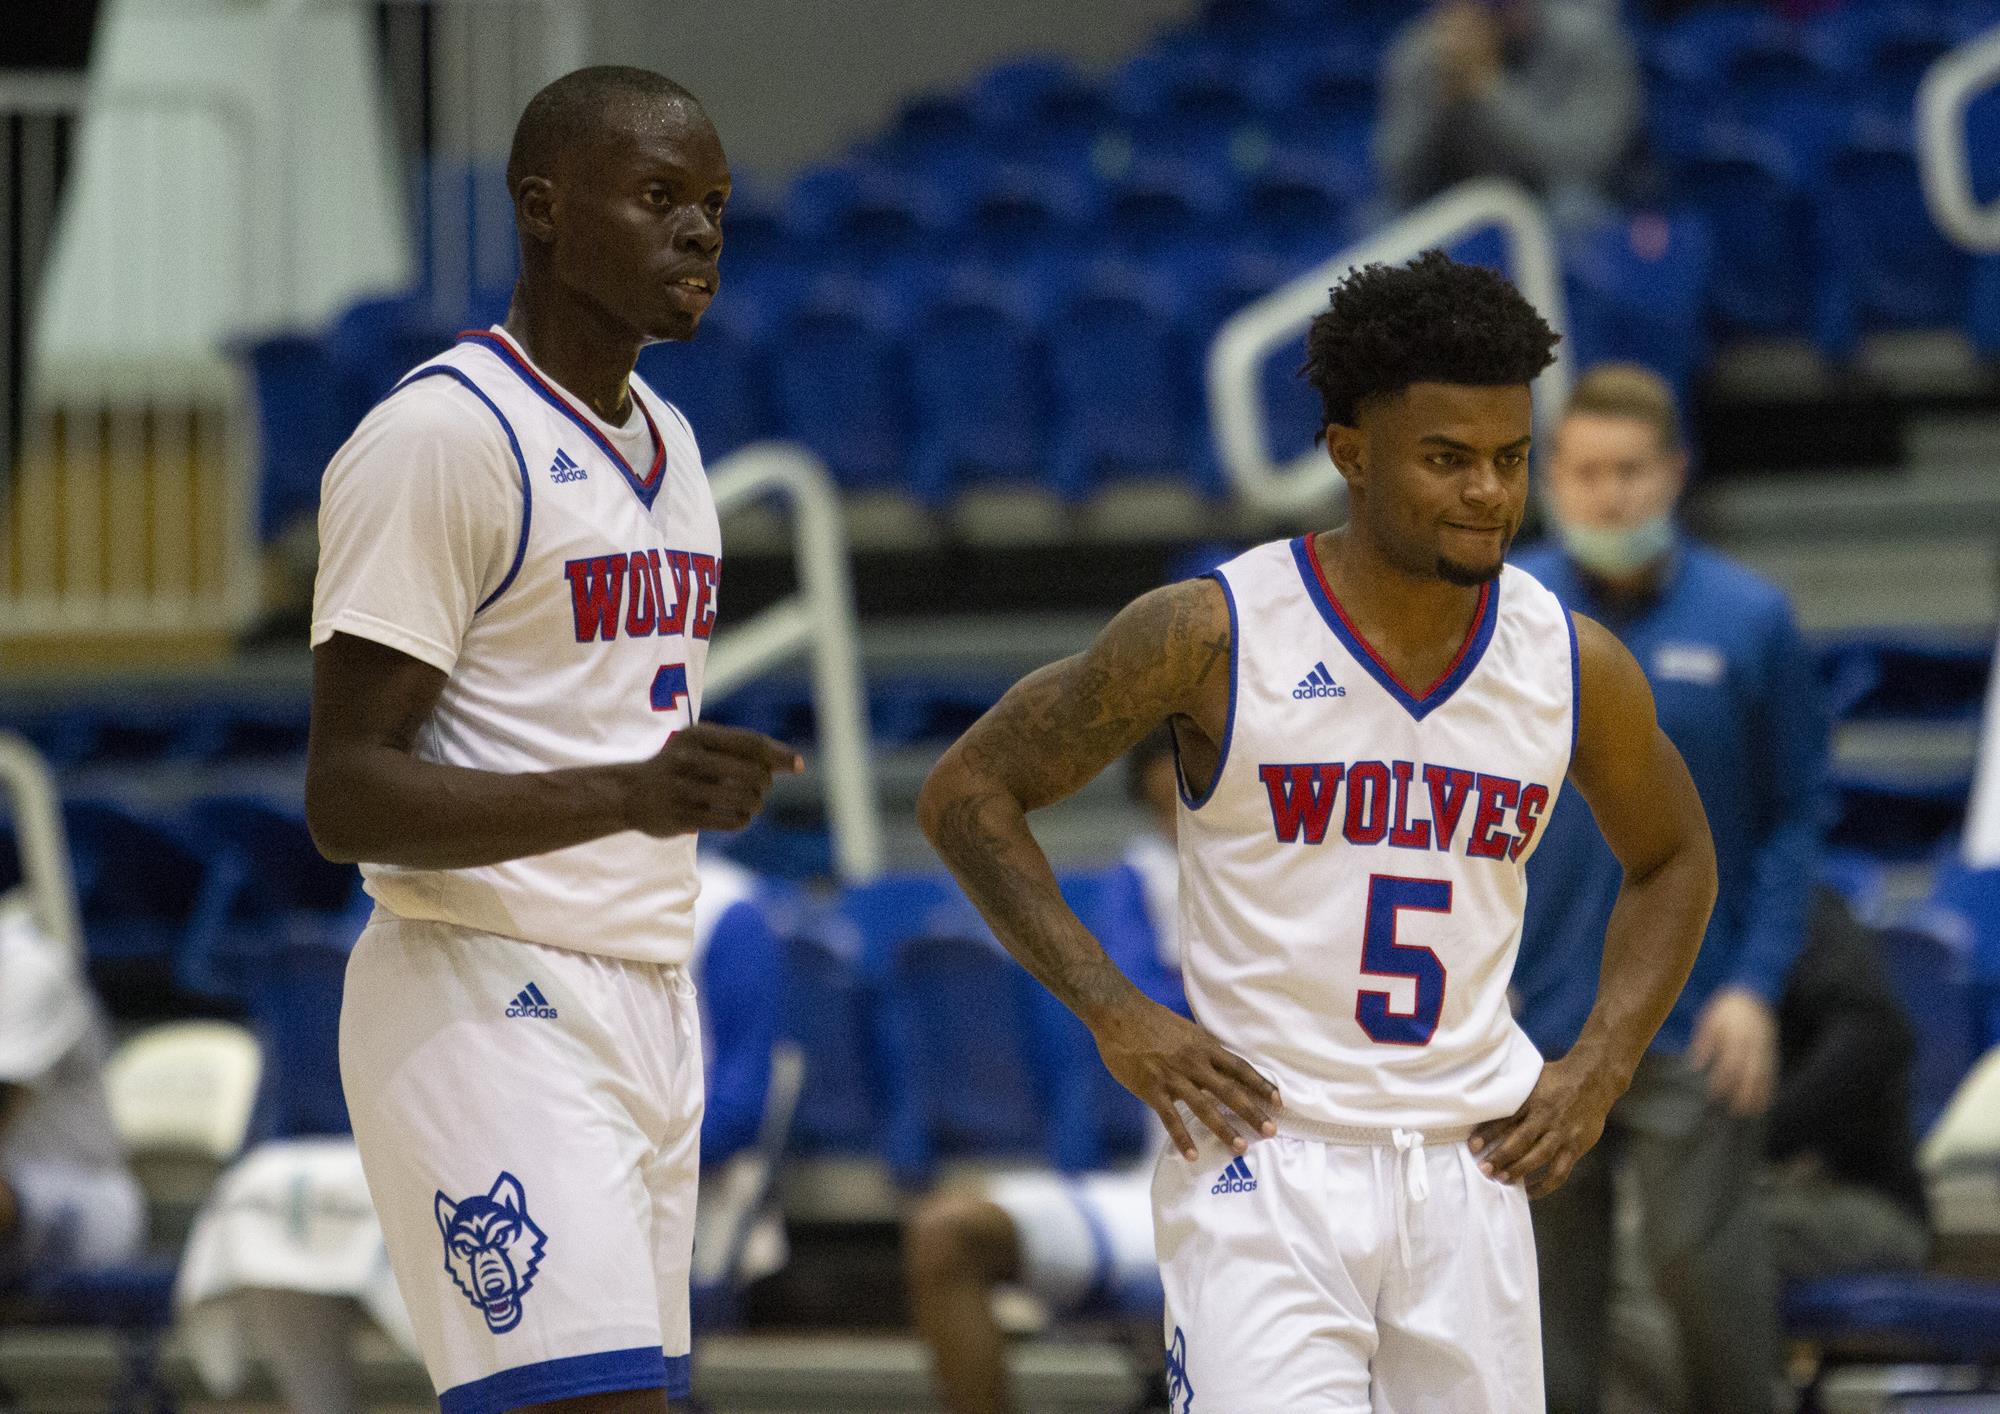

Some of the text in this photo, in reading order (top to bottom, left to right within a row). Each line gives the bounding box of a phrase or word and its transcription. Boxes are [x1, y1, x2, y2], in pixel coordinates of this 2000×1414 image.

[564, 548, 722, 643] WOLVE
[1292, 685, 1346, 699] adidas
[1258, 760, 1550, 864] WOLVES
[1354, 873, 1453, 1047] 5
[505, 1006, 558, 1019] adidas
[1211, 1179, 1258, 1195] adidas
